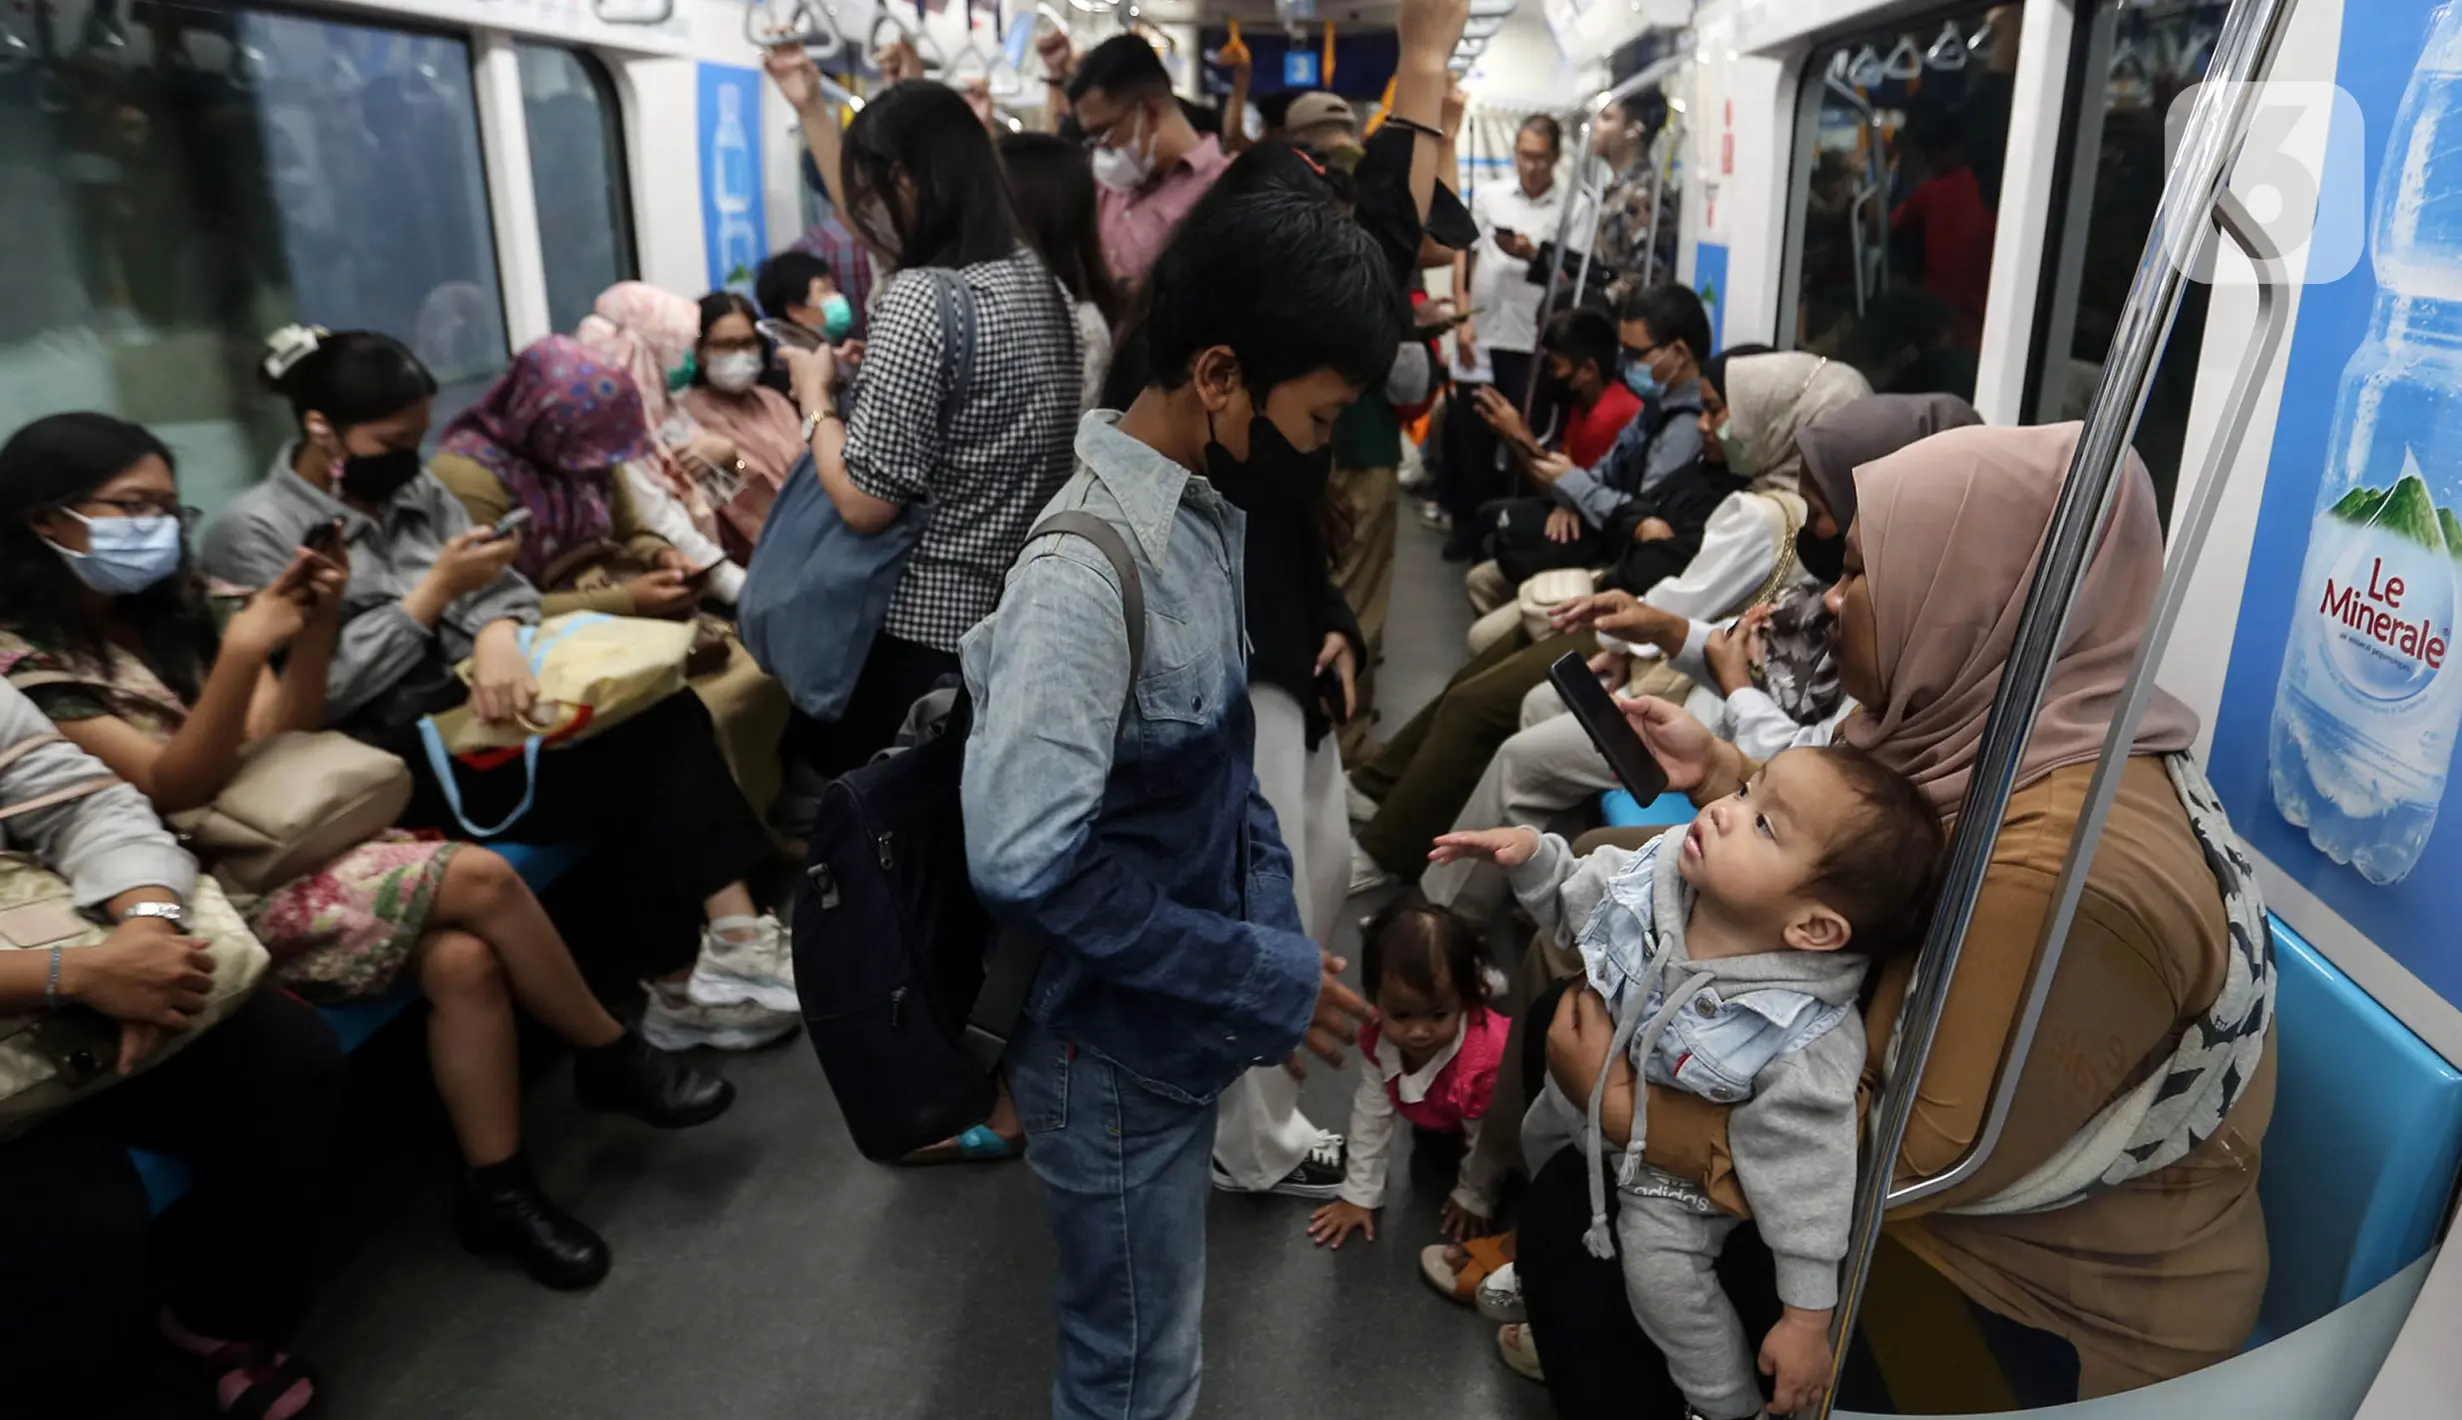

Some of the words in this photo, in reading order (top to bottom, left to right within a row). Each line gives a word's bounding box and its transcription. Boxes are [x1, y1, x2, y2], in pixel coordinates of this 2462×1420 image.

[2368, 557, 2405, 608] Le
[2319, 578, 2446, 669] Minerale
[1634, 1185, 1709, 1211] adidas
